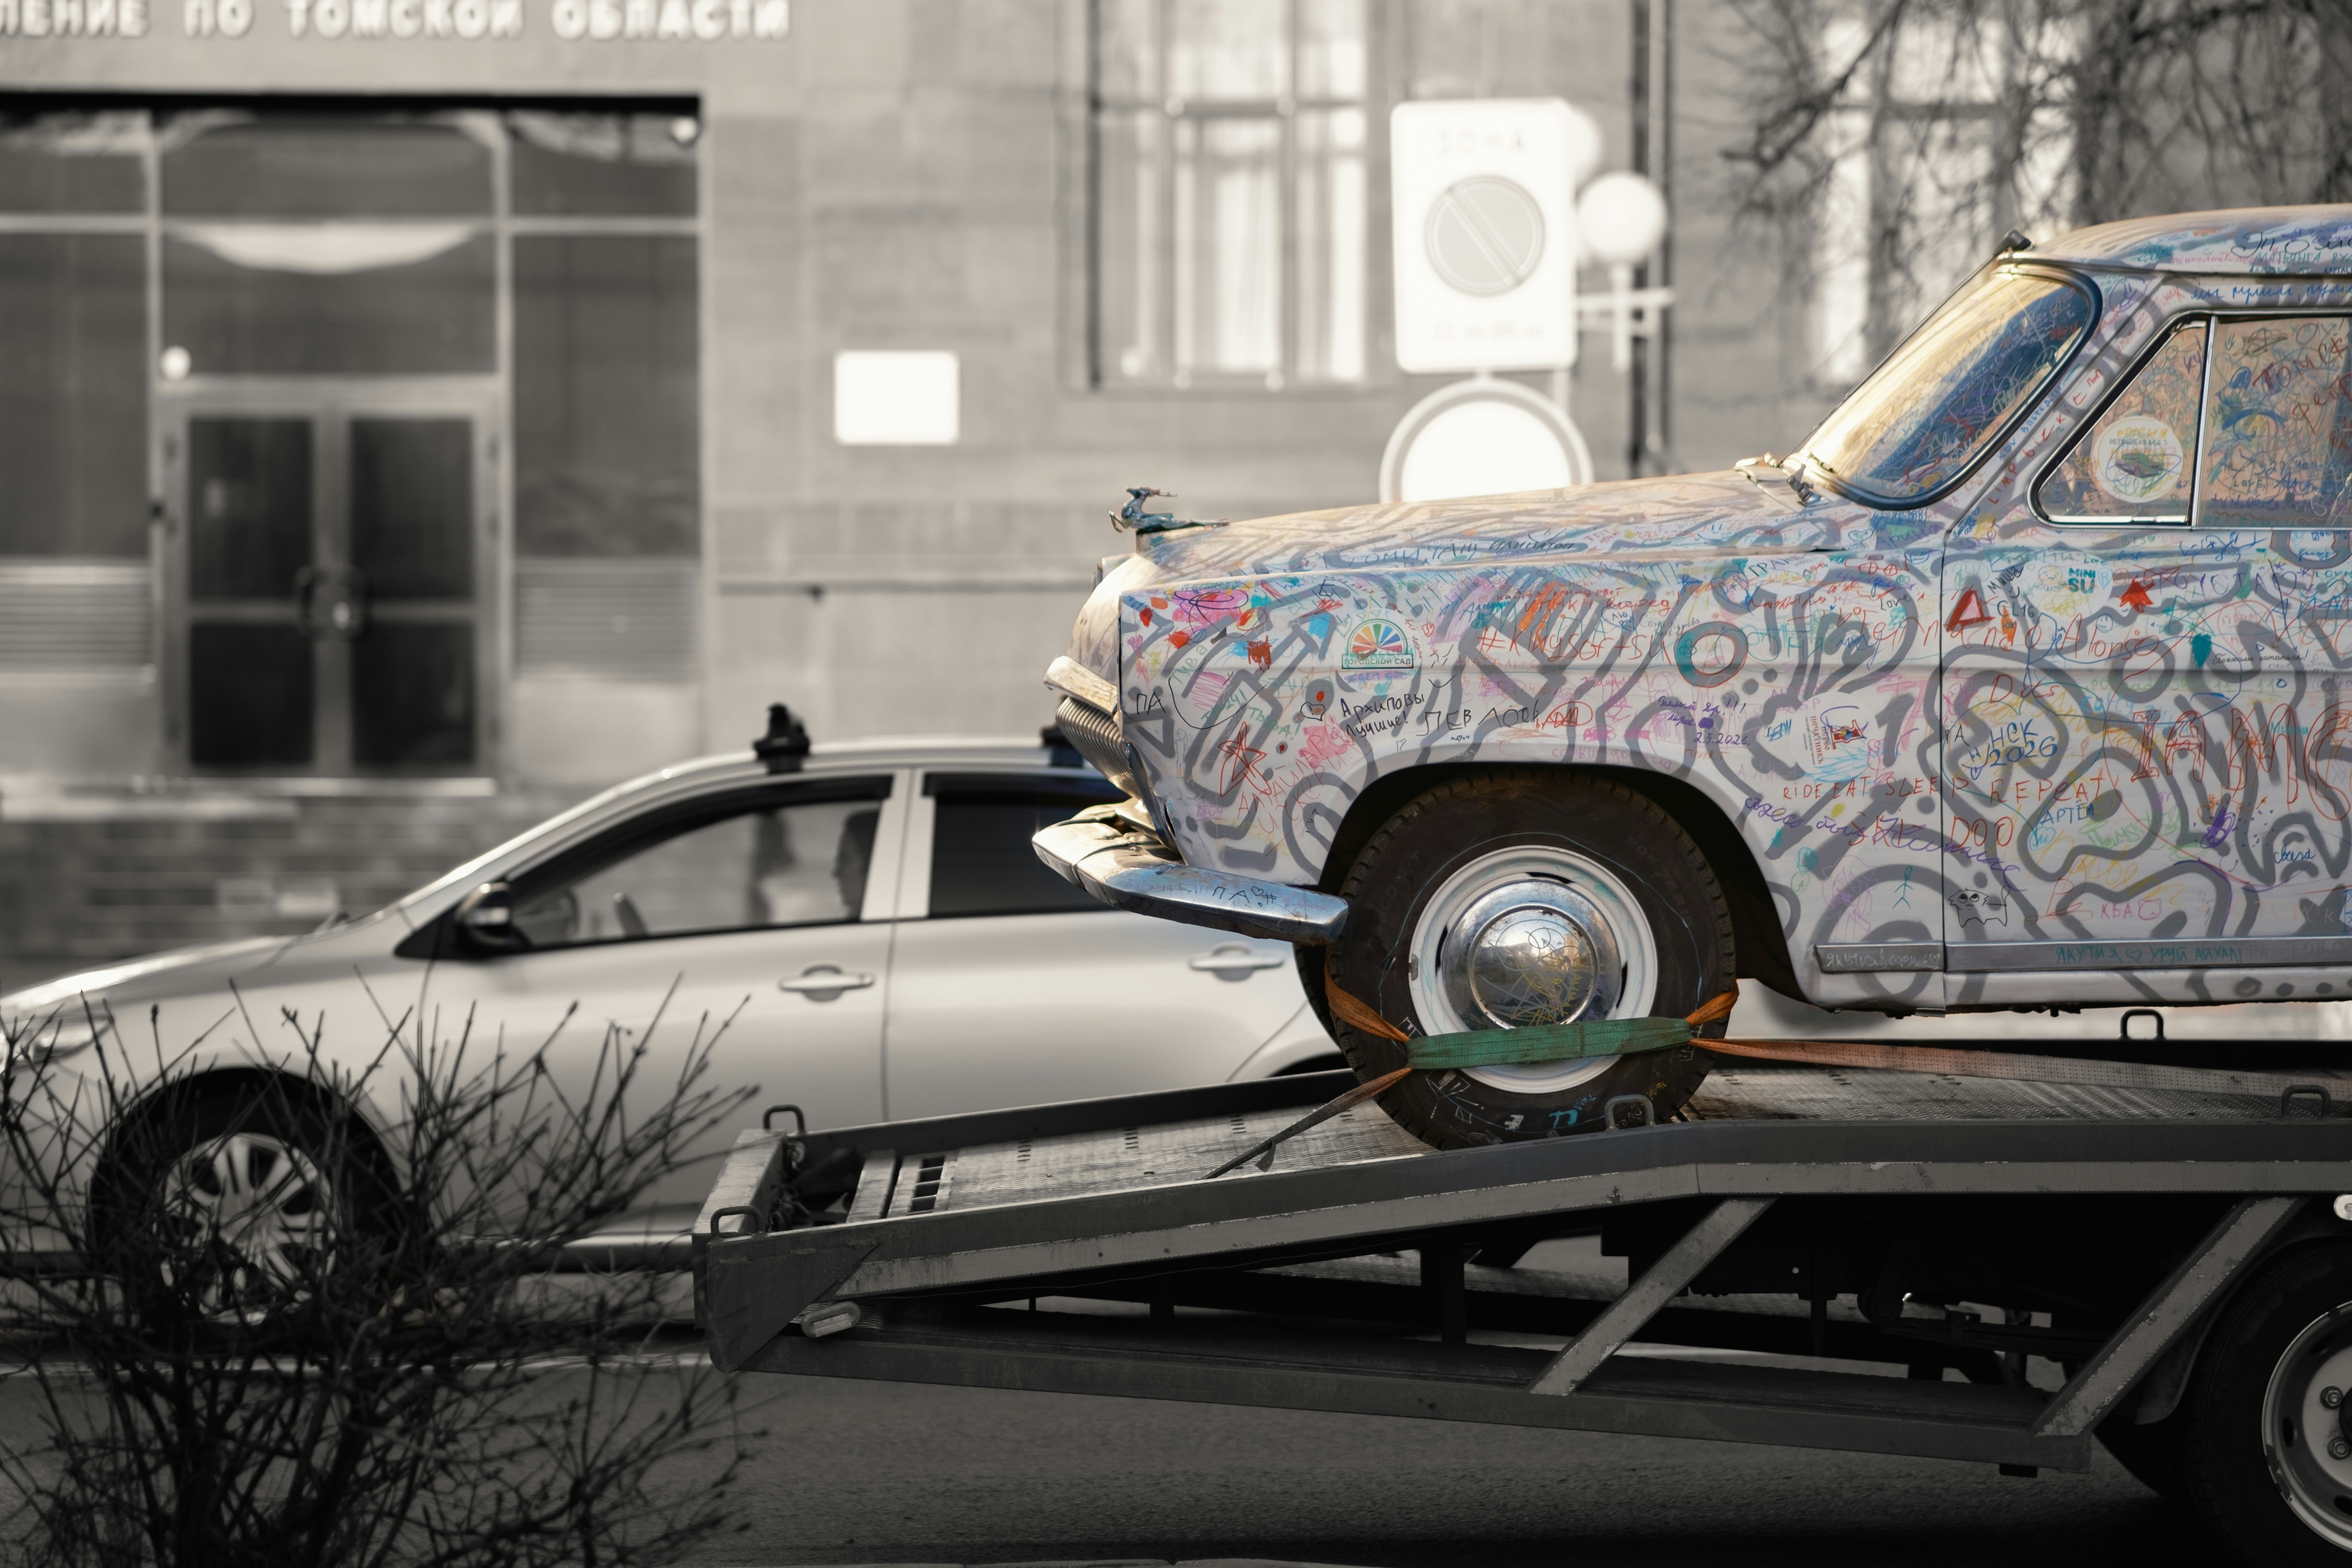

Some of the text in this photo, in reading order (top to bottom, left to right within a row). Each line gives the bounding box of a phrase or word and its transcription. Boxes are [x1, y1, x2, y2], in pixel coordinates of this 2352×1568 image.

[2068, 567, 2096, 579] MINI
[2067, 577, 2096, 594] SU
[1997, 600, 2035, 618] CL16
[1344, 657, 1392, 665] ГОРОДСКОЙ
[1340, 693, 1425, 723] Архиповы
[1989, 735, 2059, 767] 2026
[1832, 775, 1871, 800] EAT
[2056, 945, 2124, 965] ЯКУТИЯ
